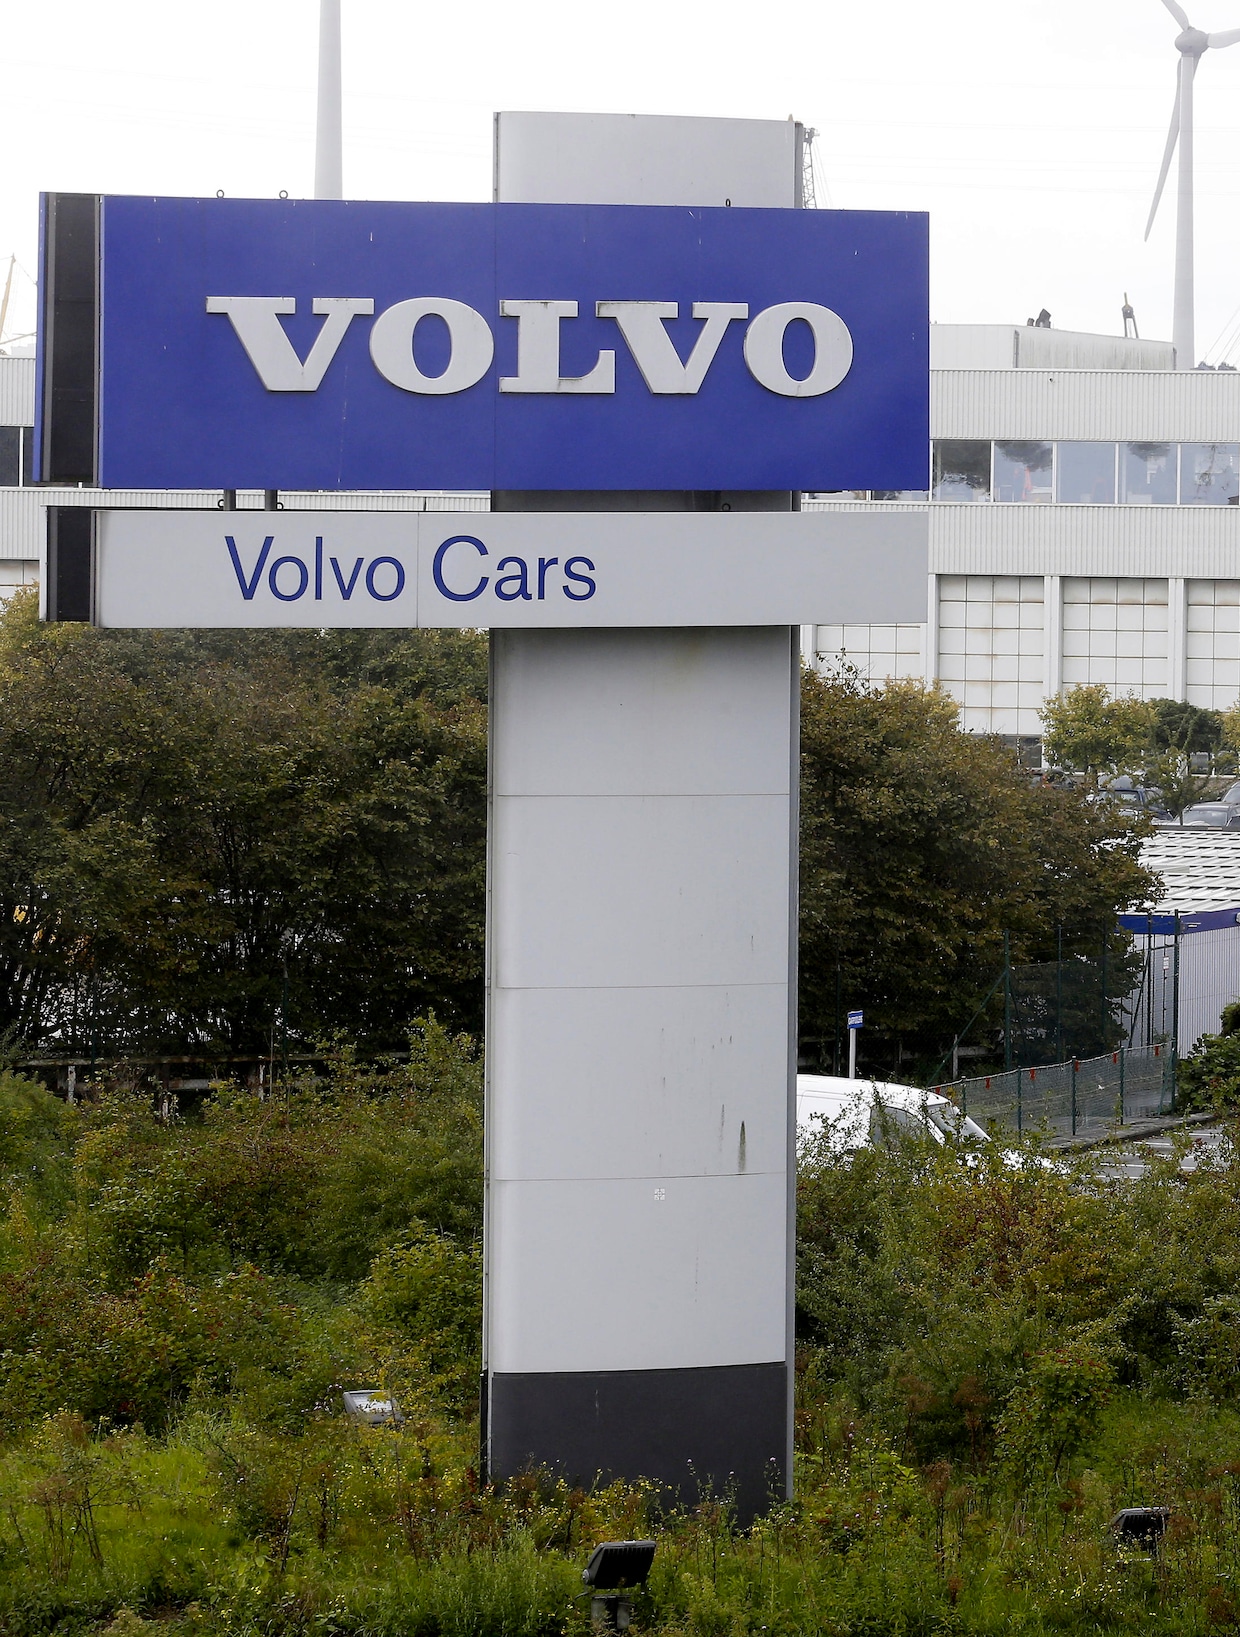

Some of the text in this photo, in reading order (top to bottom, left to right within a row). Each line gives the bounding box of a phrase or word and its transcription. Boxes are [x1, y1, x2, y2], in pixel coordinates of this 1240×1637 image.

[205, 296, 855, 397] VOLVO
[224, 535, 598, 603] Volvo Cars
